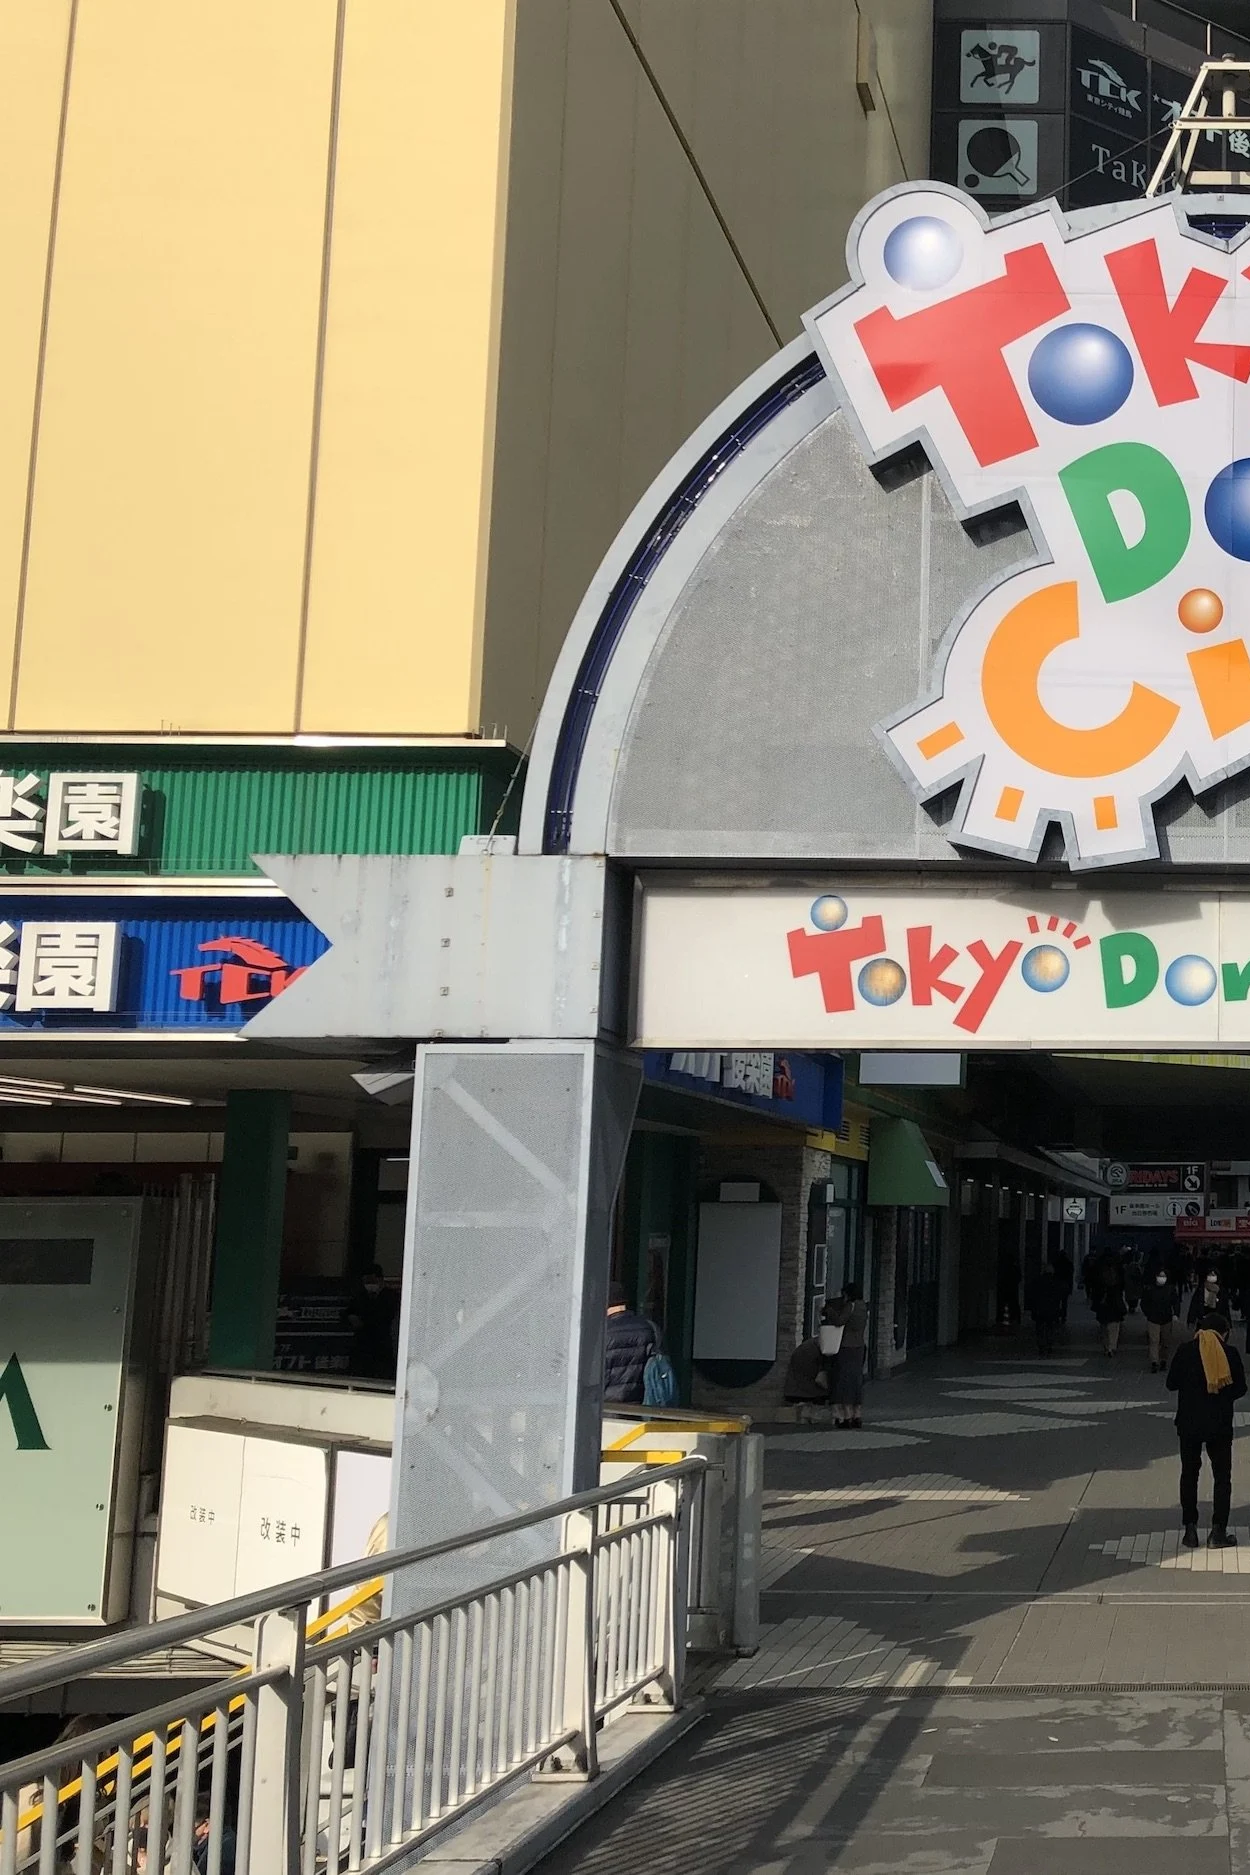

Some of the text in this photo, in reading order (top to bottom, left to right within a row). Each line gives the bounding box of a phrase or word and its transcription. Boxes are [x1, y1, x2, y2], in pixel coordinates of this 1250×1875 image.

[1076, 65, 1142, 112] TCK
[0, 920, 121, 1012] 園
[787, 905, 1072, 1035] Tokyo
[1127, 1169, 1179, 1184] RIDAYS
[1186, 1166, 1199, 1175] 1F
[1115, 1205, 1127, 1215] 1F
[189, 1504, 215, 1525] 改装中
[260, 1517, 301, 1547] 改装中
